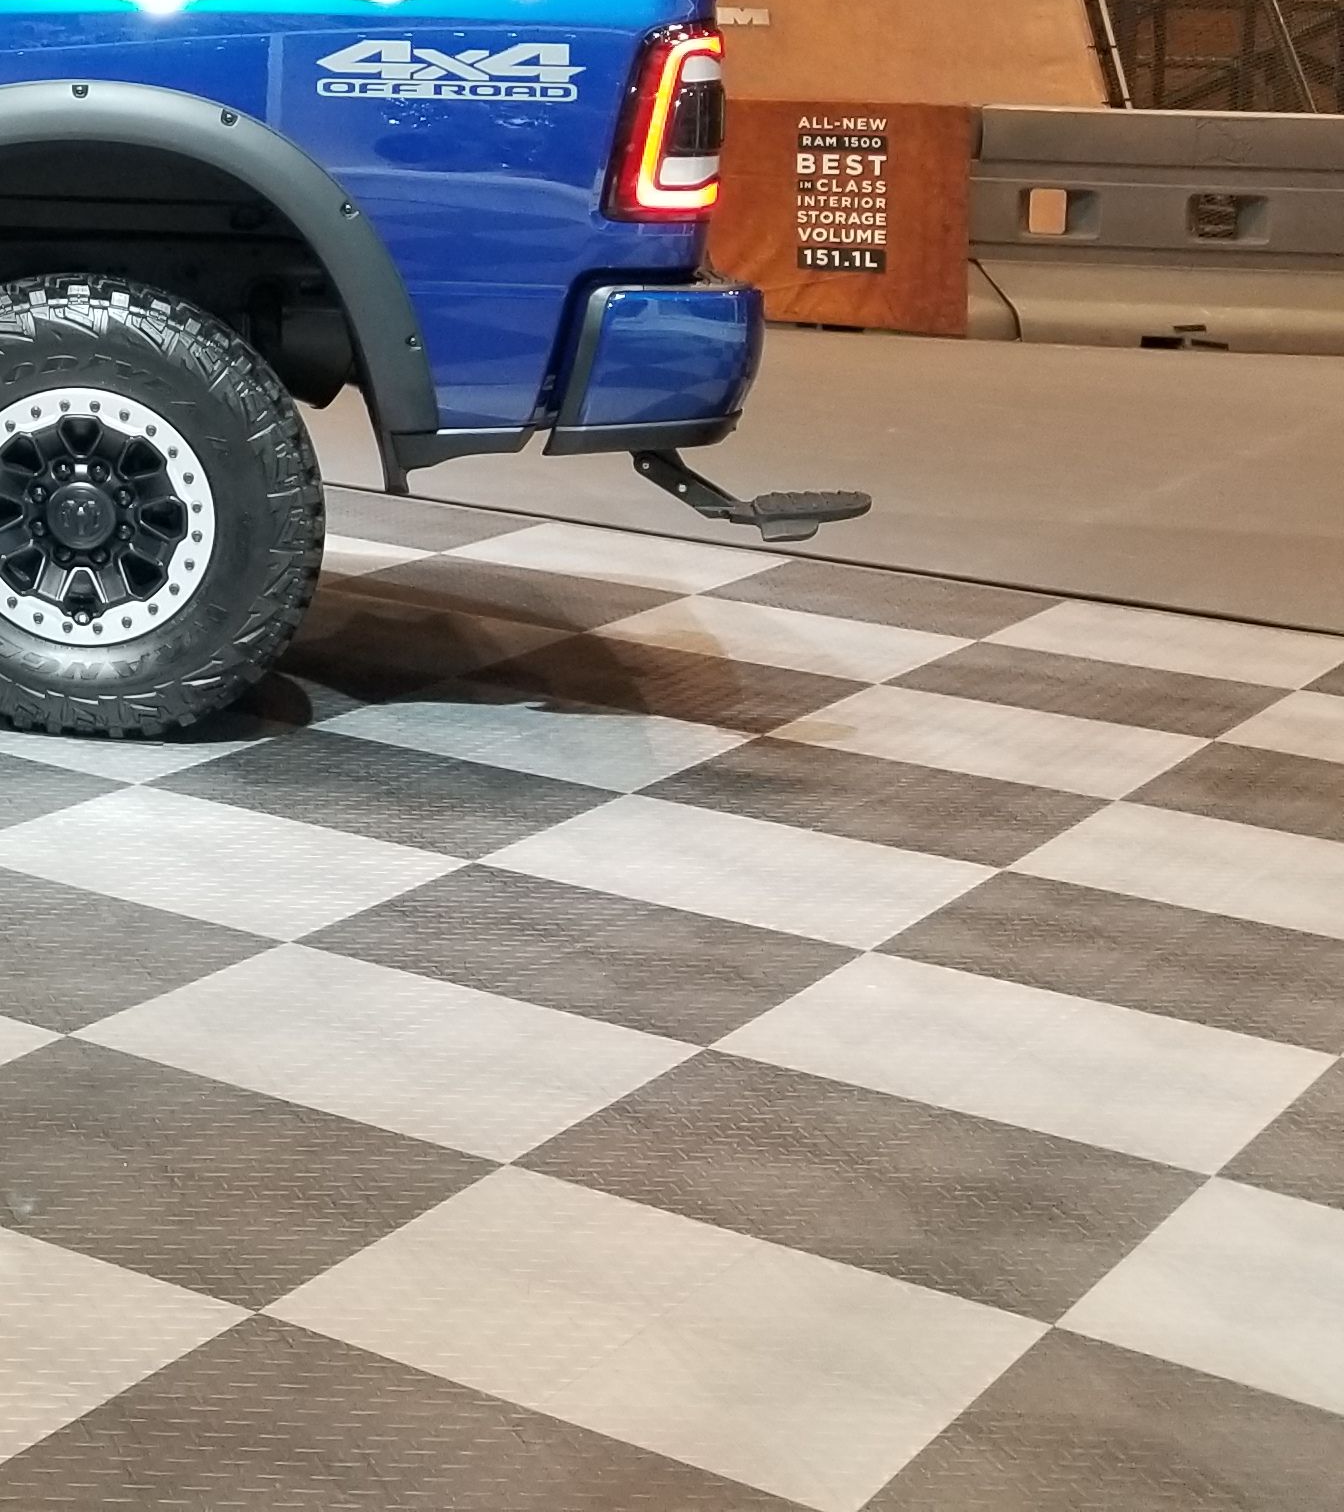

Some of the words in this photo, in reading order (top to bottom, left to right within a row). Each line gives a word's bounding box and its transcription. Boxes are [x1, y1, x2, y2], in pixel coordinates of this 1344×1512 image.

[316, 39, 587, 82] 4x4
[321, 80, 424, 98] OFF
[442, 81, 575, 100] ROAD
[798, 116, 887, 131] ALL-NEW
[802, 136, 837, 147] RAM
[843, 136, 882, 148] 1500
[796, 153, 887, 176] BEST
[799, 180, 812, 189] IN
[816, 179, 887, 193] CLASS
[797, 195, 886, 209] INTERIOR
[797, 210, 887, 226] STORAGE
[797, 227, 887, 245] VOLUME
[803, 249, 878, 269] 151.1L
